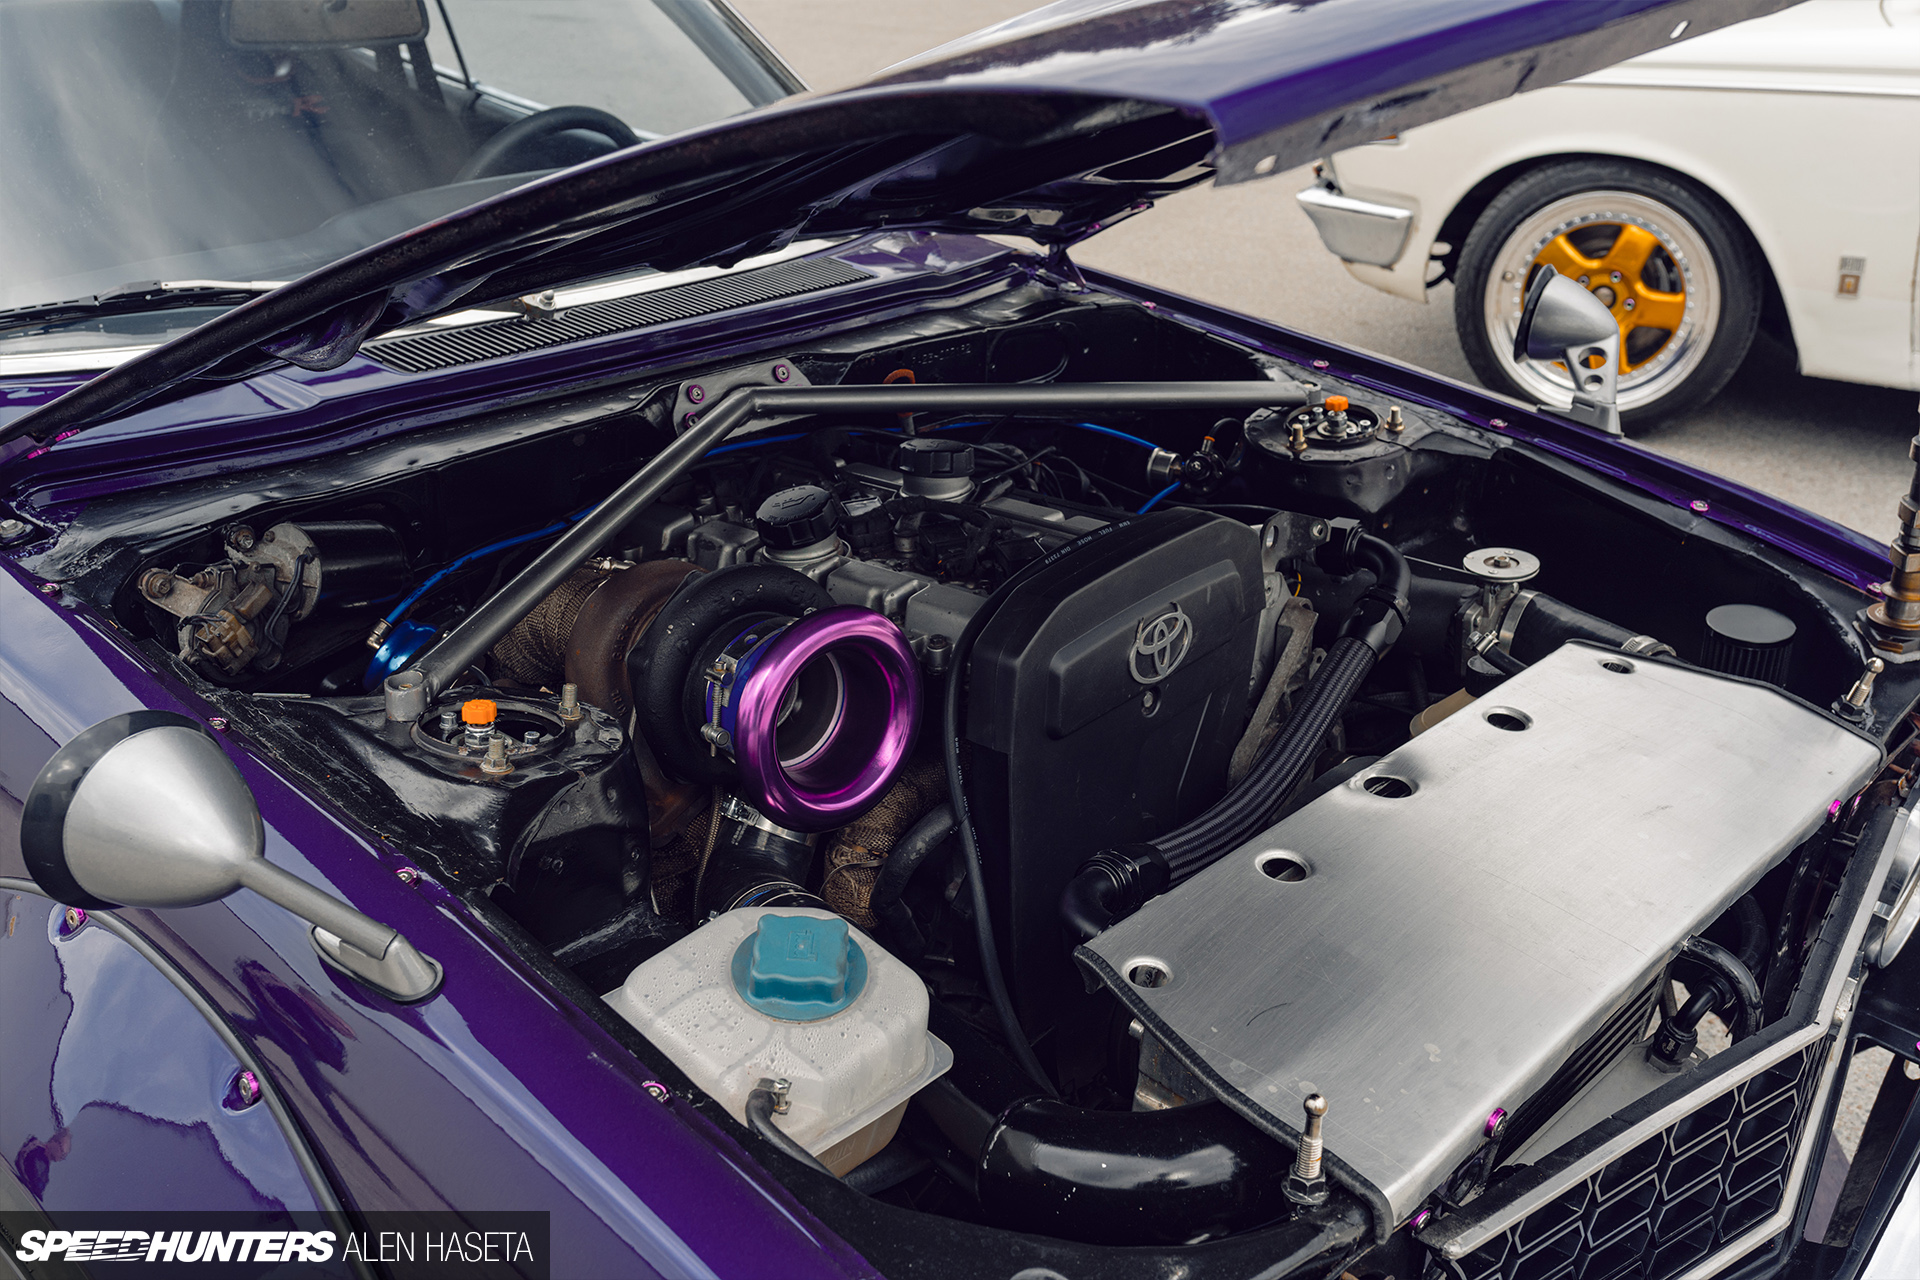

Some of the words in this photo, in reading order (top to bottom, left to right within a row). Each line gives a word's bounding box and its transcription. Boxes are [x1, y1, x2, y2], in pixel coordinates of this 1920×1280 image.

[1098, 527, 1113, 536] FUEL
[1077, 536, 1093, 546] HOSE
[1060, 546, 1071, 555] DIN
[824, 1138, 856, 1166] MIN
